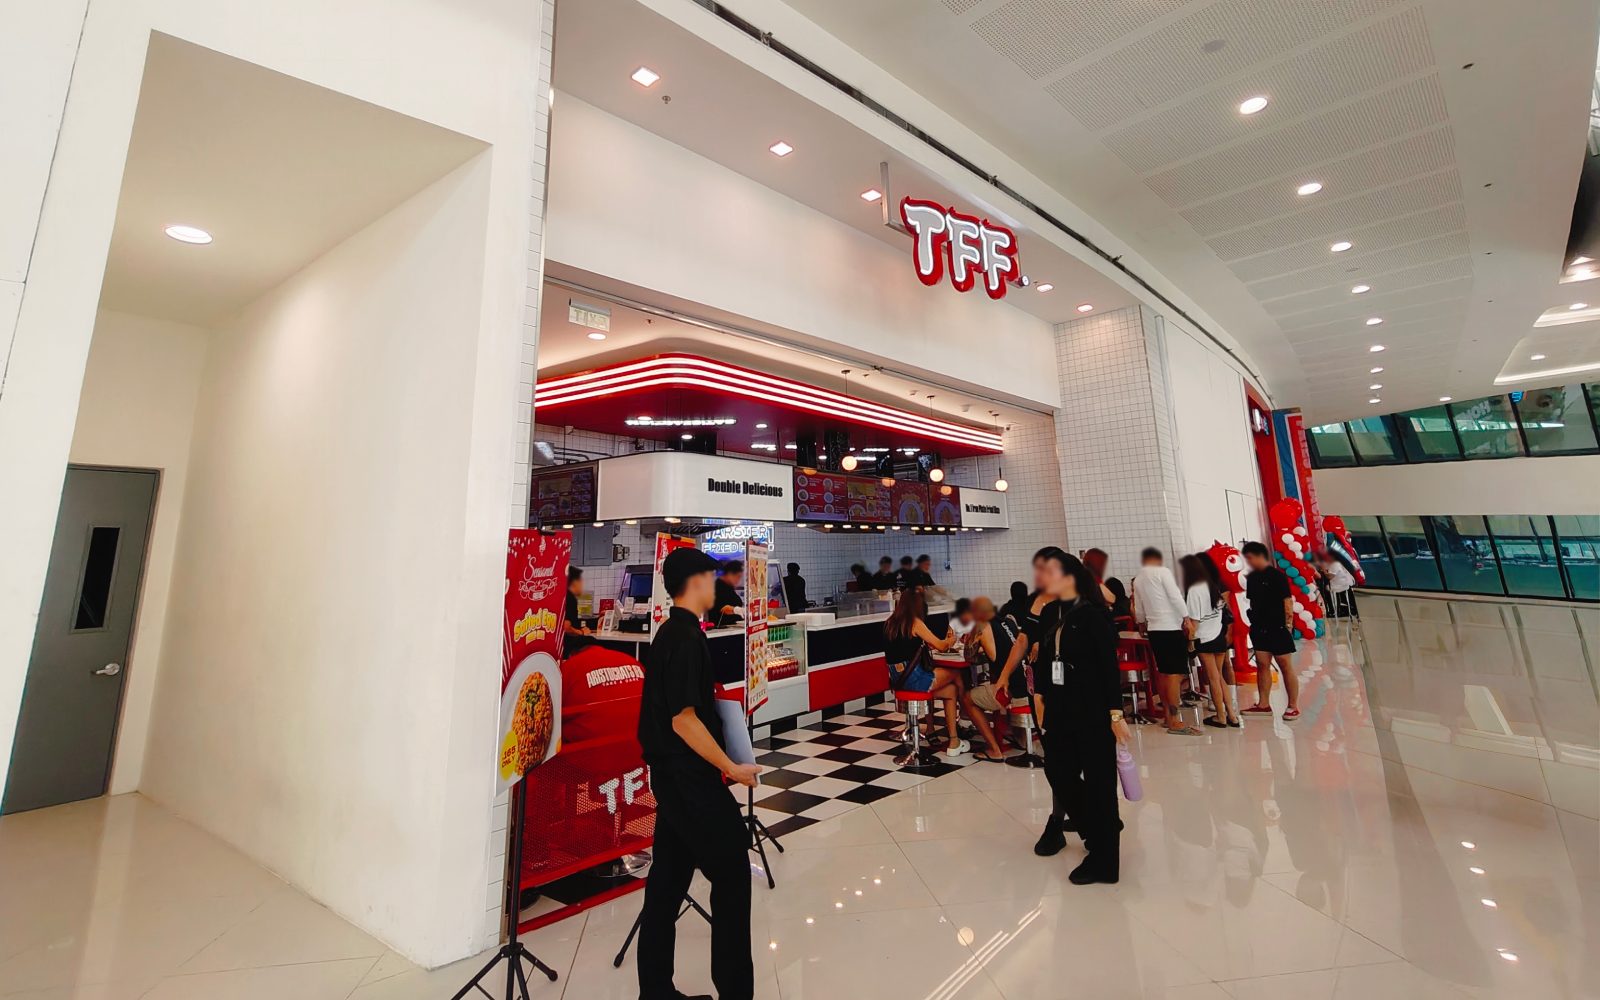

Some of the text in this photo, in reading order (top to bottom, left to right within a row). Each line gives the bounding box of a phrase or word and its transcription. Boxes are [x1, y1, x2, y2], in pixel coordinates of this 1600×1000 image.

[708, 478, 783, 497] Double Delicious
[702, 542, 739, 553] FRIED
[1001, 621, 1017, 645] UNDE
[598, 765, 652, 814] TF
